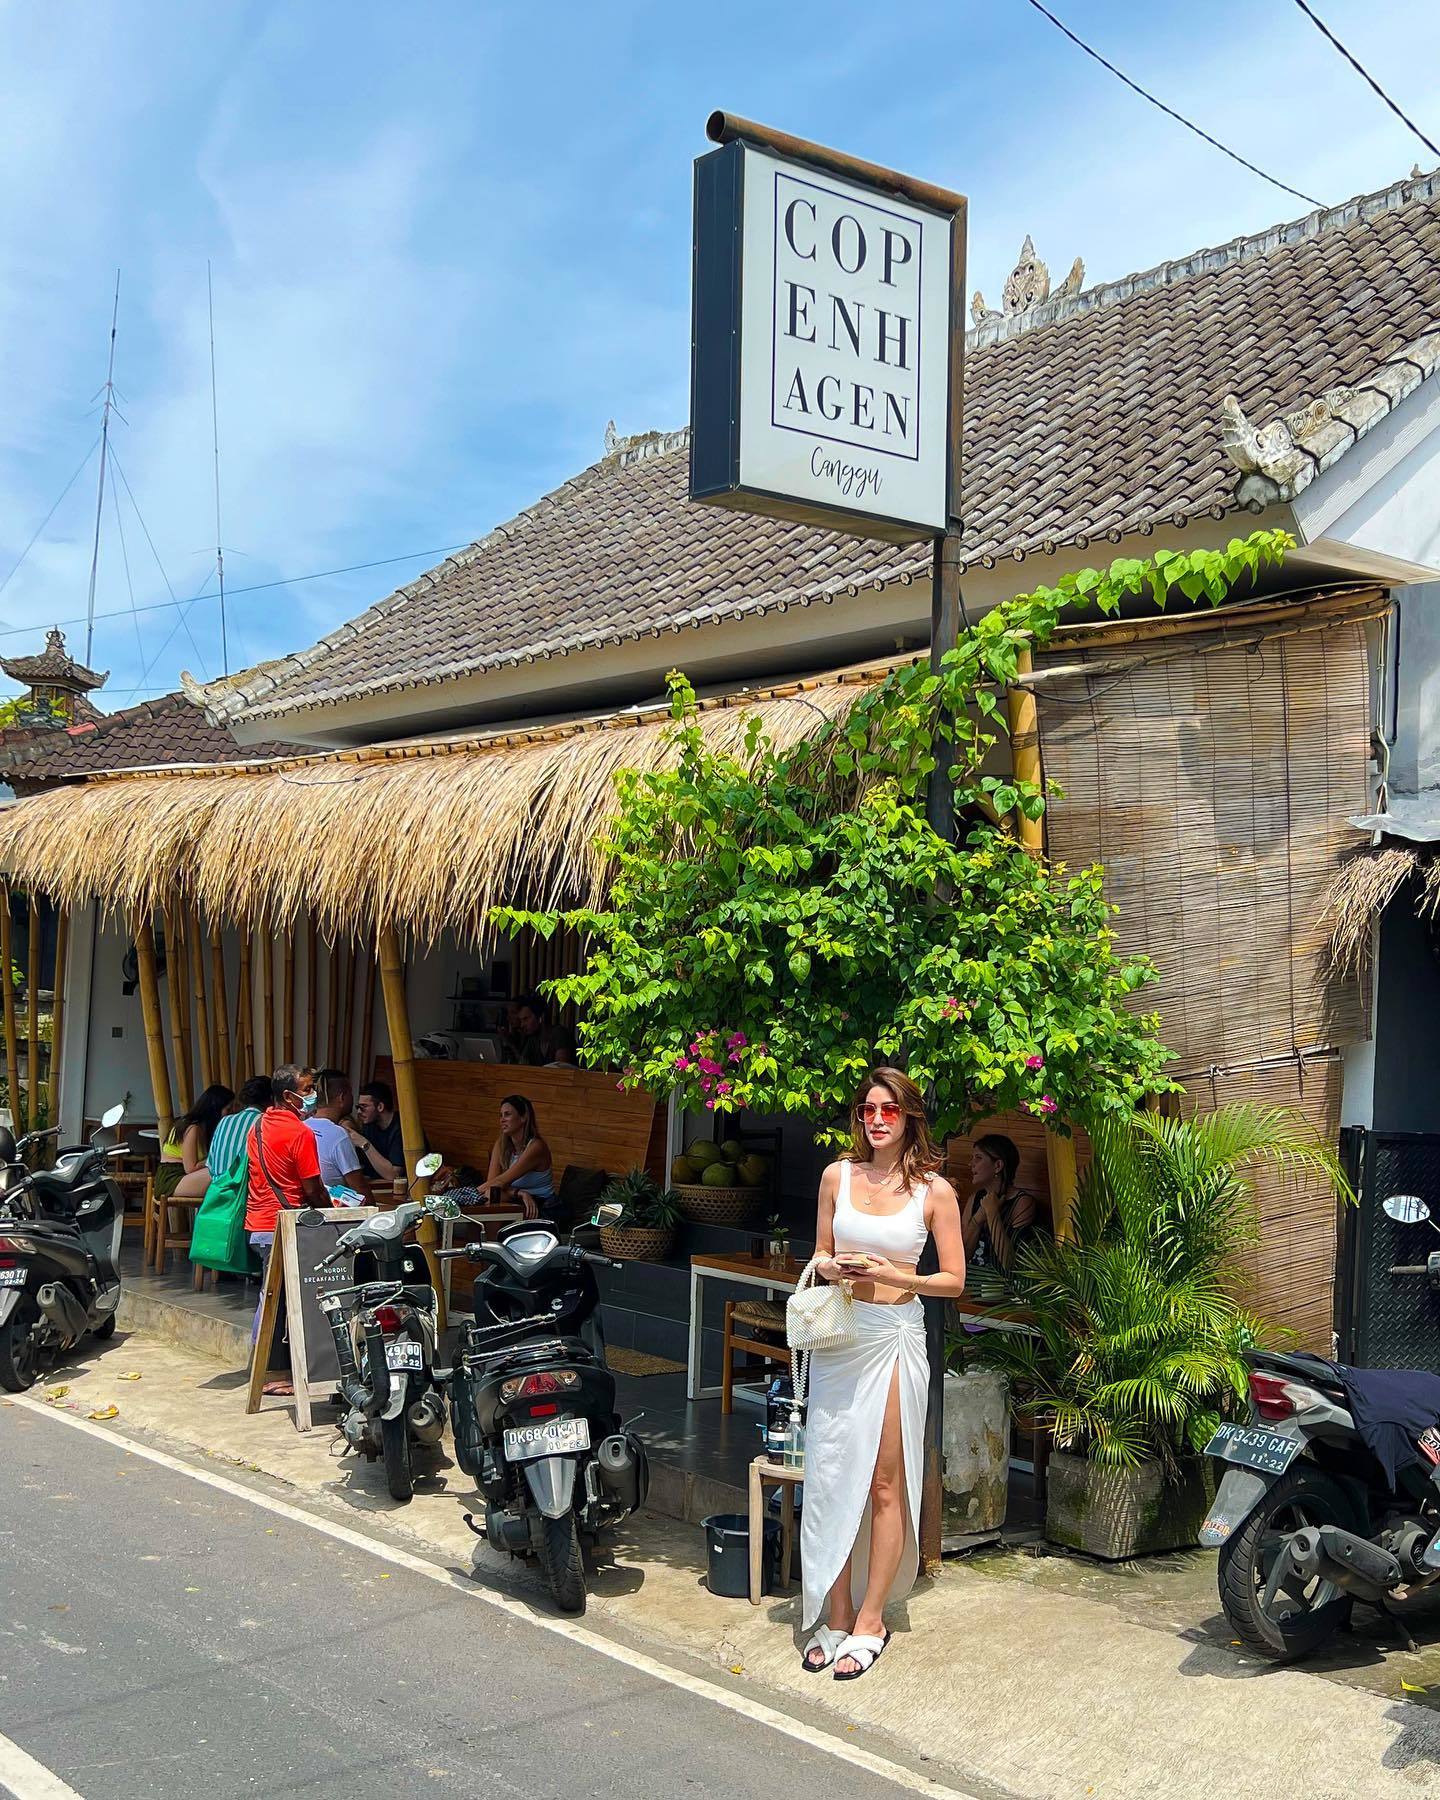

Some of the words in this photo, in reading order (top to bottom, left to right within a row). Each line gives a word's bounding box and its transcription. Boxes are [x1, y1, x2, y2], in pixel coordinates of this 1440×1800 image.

[785, 198, 912, 288] COP
[783, 280, 912, 371] ENH
[782, 366, 910, 440] AGEN
[809, 446, 883, 497] Canggu
[303, 1275, 339, 1283] BREAKFAST
[1216, 1425, 1236, 1440] DK
[1233, 1429, 1268, 1448] 3439
[1250, 1453, 1285, 1470] 11-22
